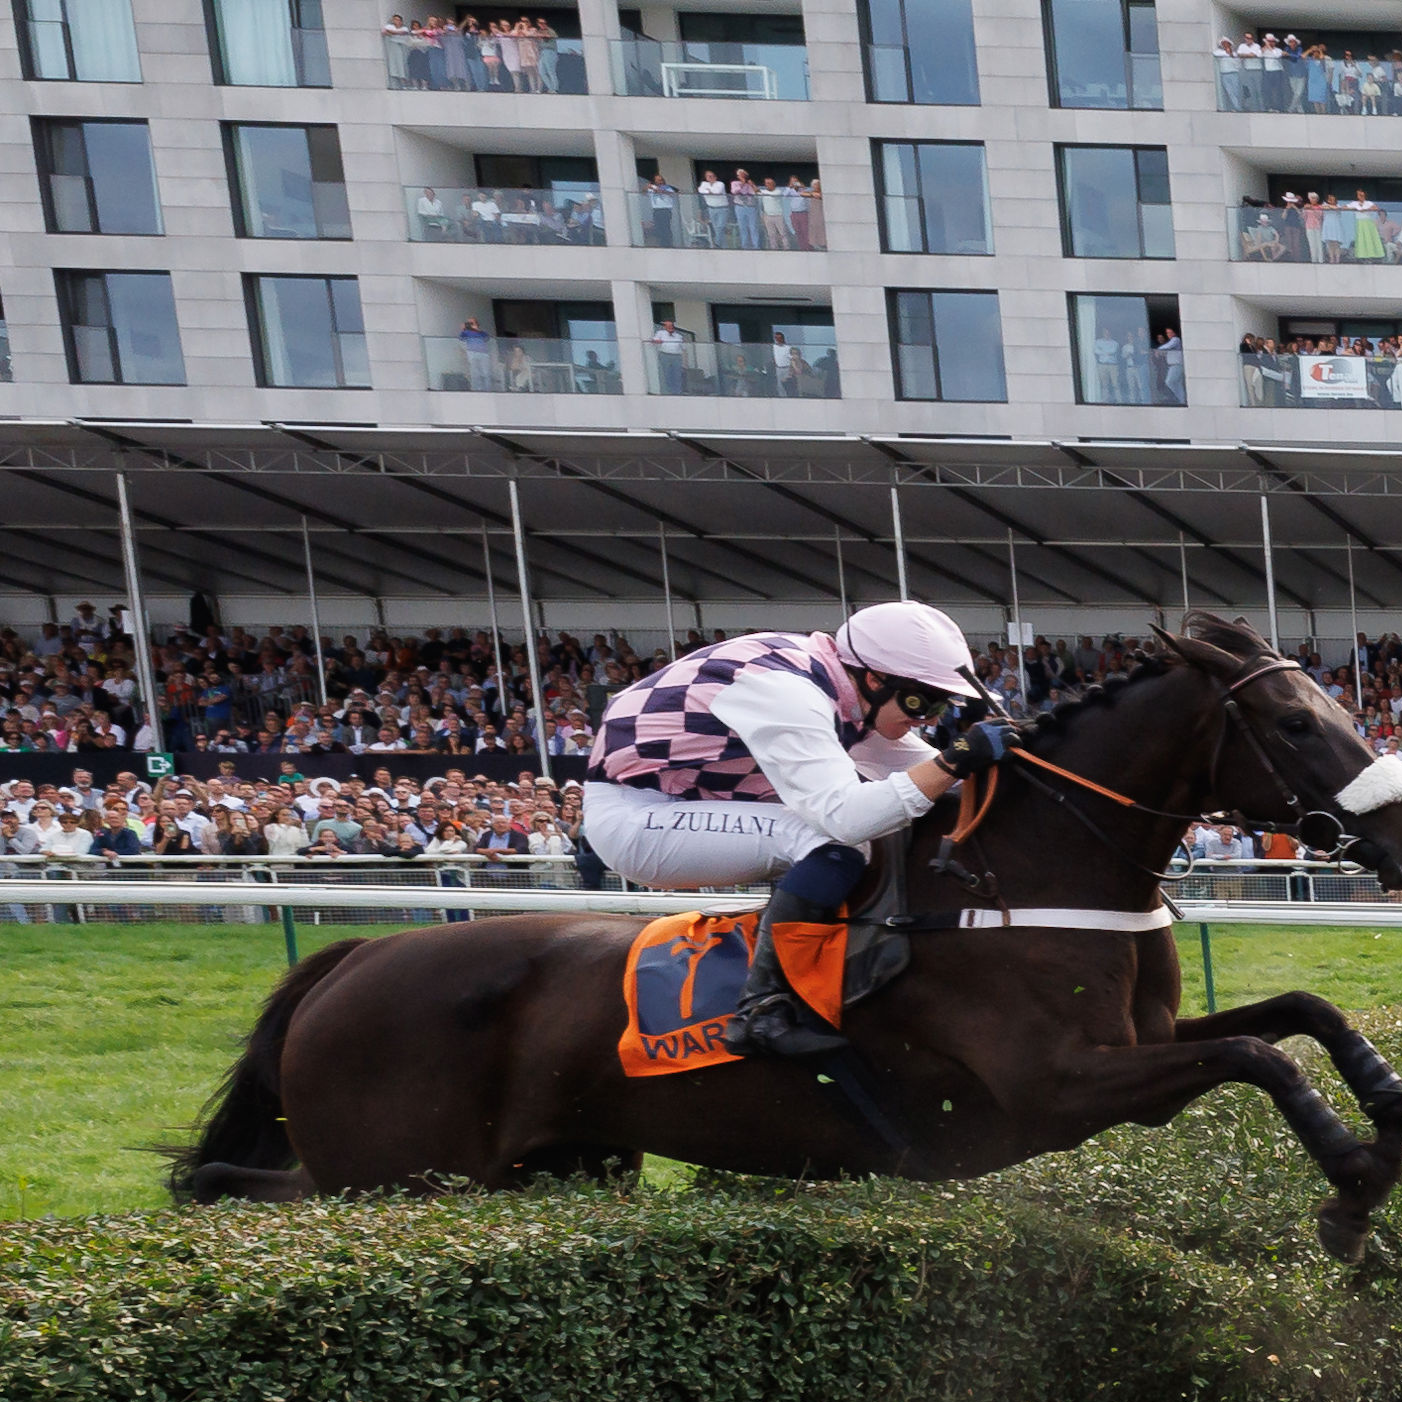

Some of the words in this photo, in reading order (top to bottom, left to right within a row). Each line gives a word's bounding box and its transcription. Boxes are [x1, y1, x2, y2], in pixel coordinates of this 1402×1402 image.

[644, 811, 664, 831] L.
[672, 811, 776, 837] ZULIANI
[670, 937, 722, 1019] 7
[641, 1022, 728, 1060] WAR
